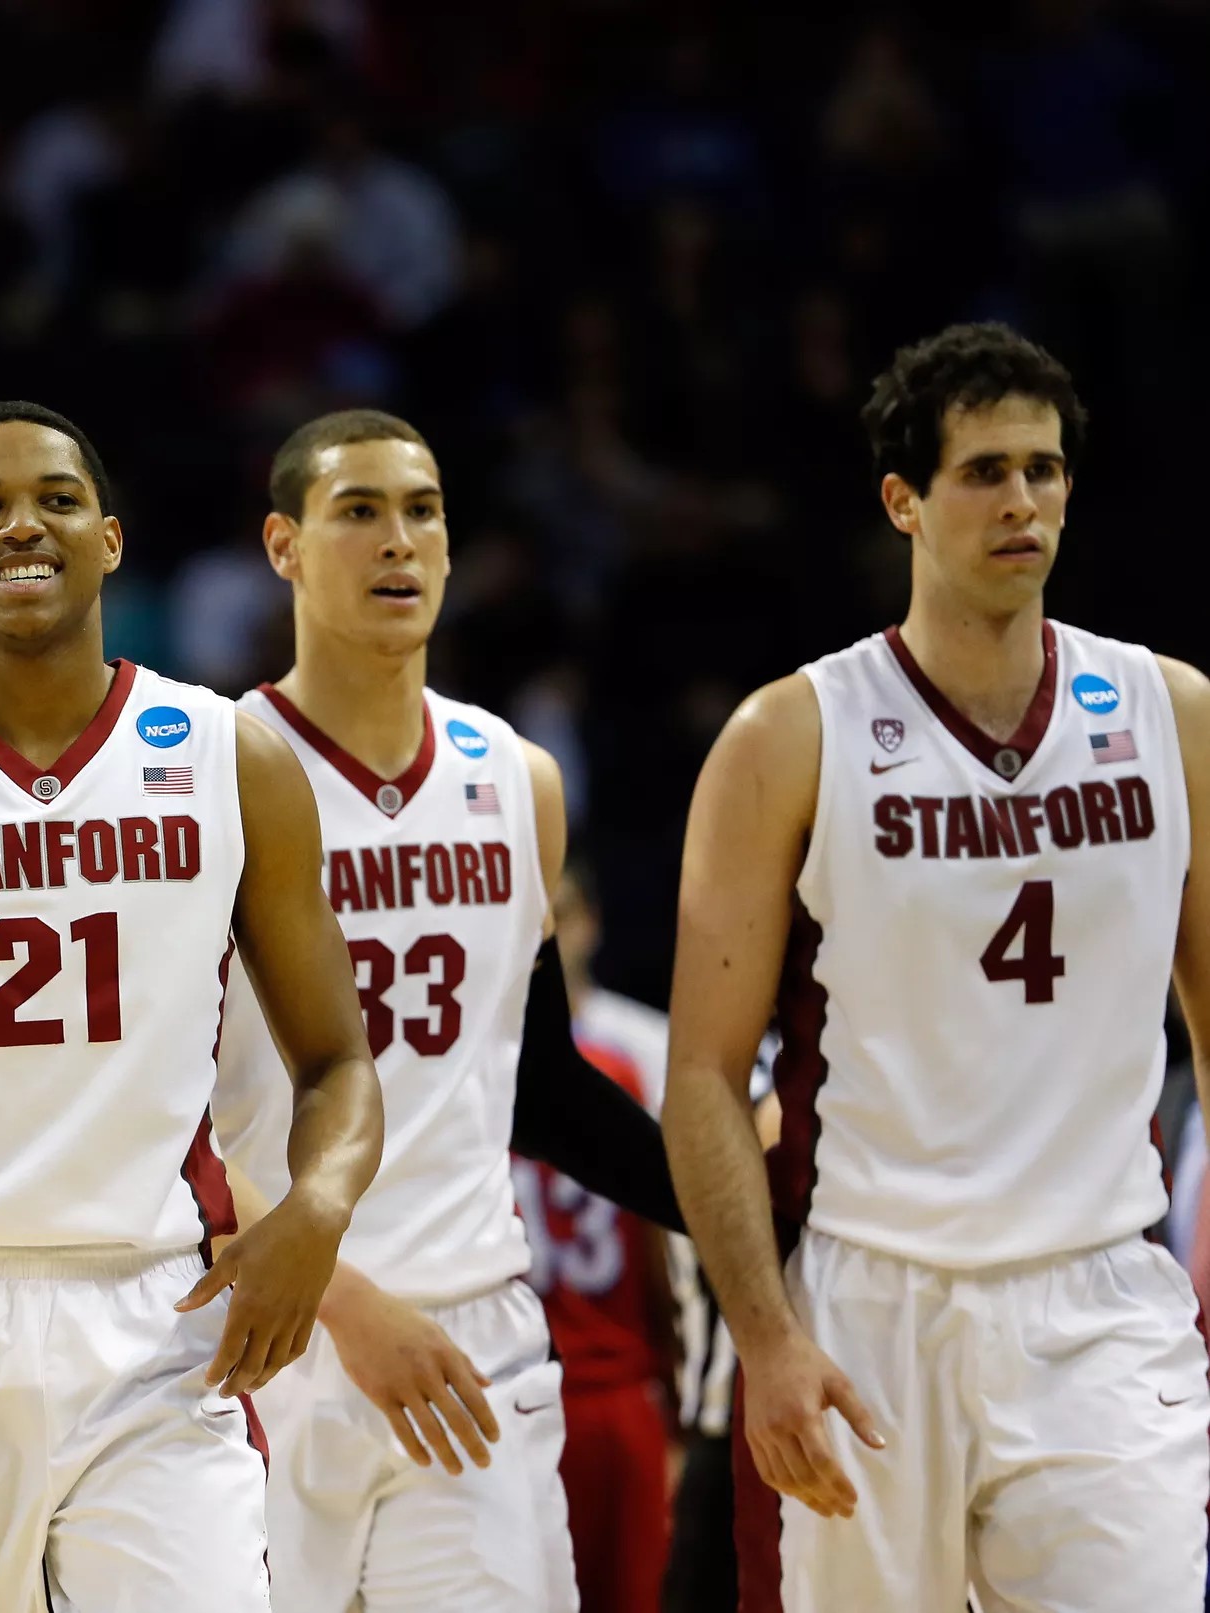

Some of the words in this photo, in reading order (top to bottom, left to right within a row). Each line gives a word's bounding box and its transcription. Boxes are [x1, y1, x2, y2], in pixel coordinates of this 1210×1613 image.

[145, 721, 188, 737] NCAA
[40, 779, 53, 796] S
[873, 776, 1156, 859] STANFORD
[321, 841, 512, 914] ANFORD
[979, 880, 1065, 1004] 4
[347, 932, 466, 1060] 33
